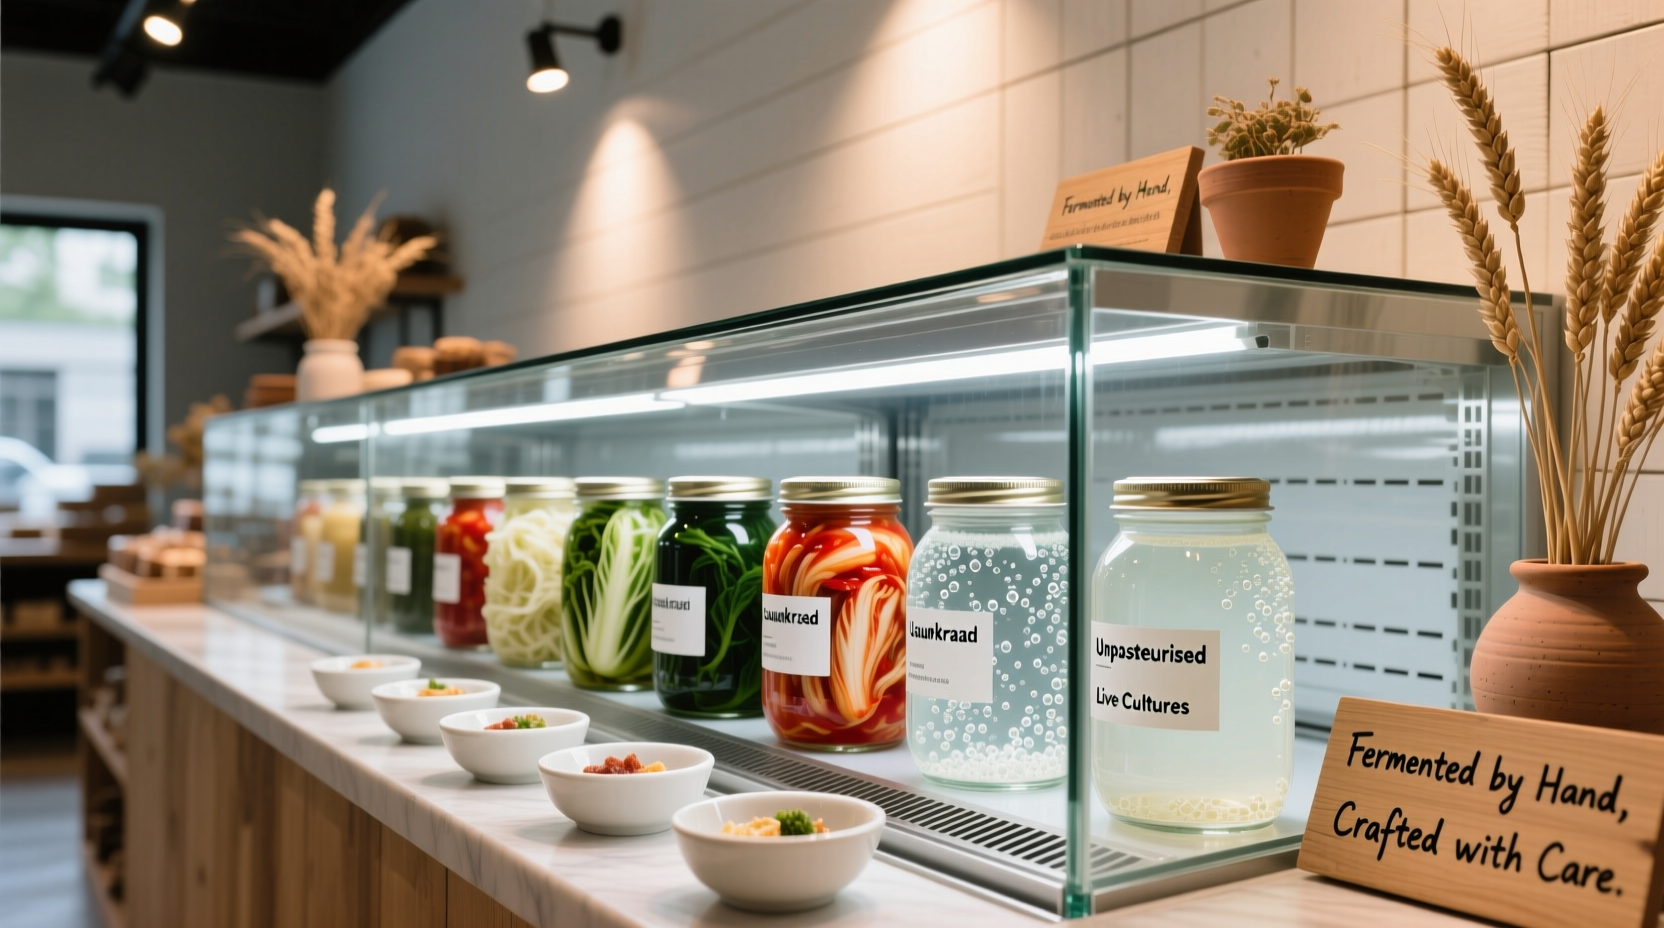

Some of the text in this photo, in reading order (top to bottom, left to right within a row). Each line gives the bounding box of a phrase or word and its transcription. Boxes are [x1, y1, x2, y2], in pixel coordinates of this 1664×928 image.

[1118, 186, 1132, 210] by
[1096, 637, 1206, 664] Unpasteurised
[1096, 686, 1190, 715] Live Cultures
[1347, 731, 1628, 824] Fermented by Hand,
[1333, 800, 1623, 898] Crafted with Care.
